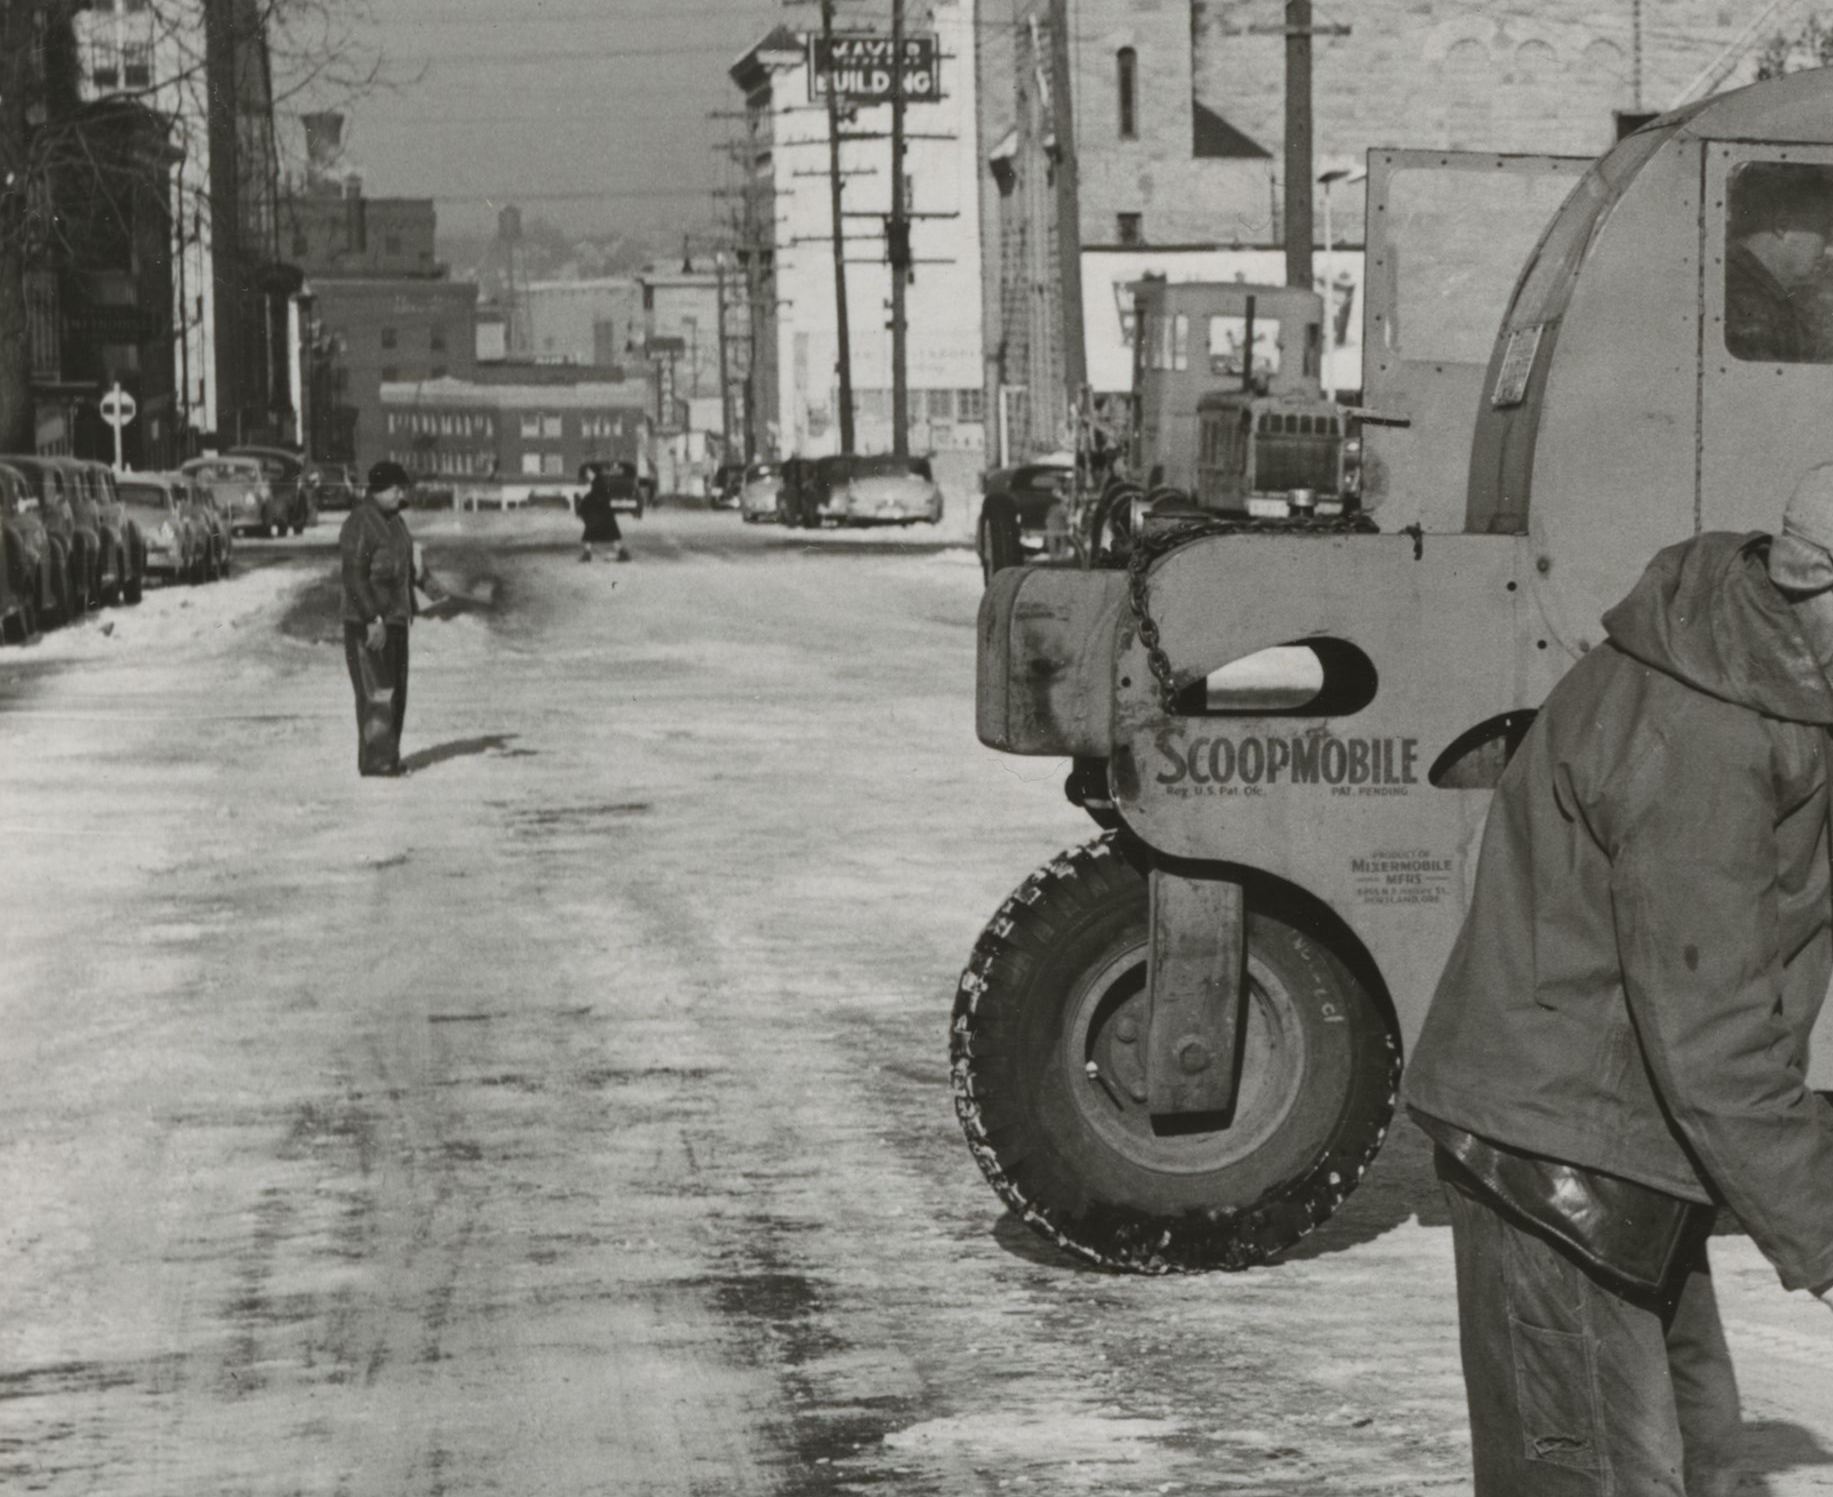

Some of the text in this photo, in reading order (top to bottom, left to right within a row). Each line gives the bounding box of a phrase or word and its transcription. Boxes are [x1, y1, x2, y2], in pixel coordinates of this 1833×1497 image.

[816, 70, 931, 94] BUILDNG
[1154, 727, 1418, 785] SCOOPMOBILE
[1359, 786, 1408, 796] PENDING
[1351, 859, 1452, 873] MIXERMOBILE
